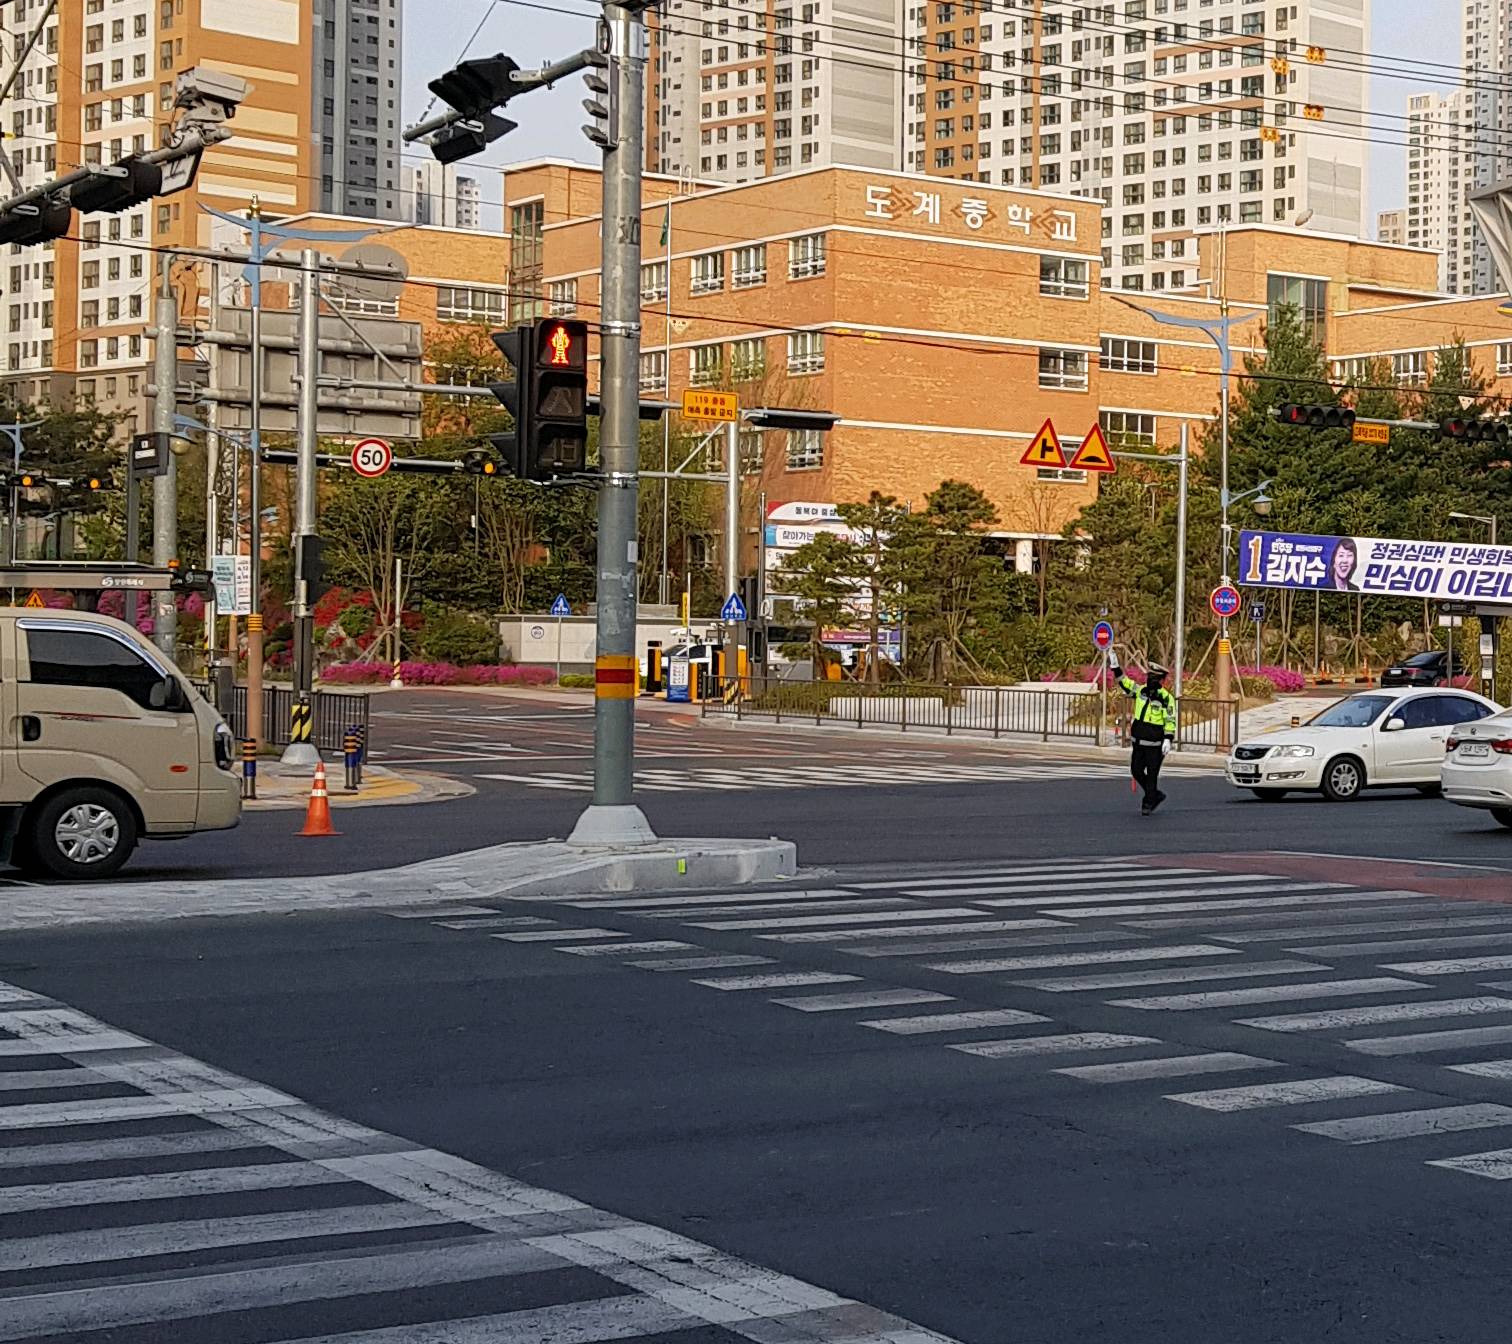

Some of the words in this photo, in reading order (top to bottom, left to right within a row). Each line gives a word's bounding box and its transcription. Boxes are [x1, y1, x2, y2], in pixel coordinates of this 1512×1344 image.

[865, 184, 1077, 242] 도계중학교
[695, 395, 709, 404] 119
[360, 449, 383, 466] 50
[1246, 535, 1263, 582] 1
[1370, 542, 1446, 564] 정권심판!
[1266, 554, 1327, 586] 김지수
[1362, 562, 1443, 594] 민심이
